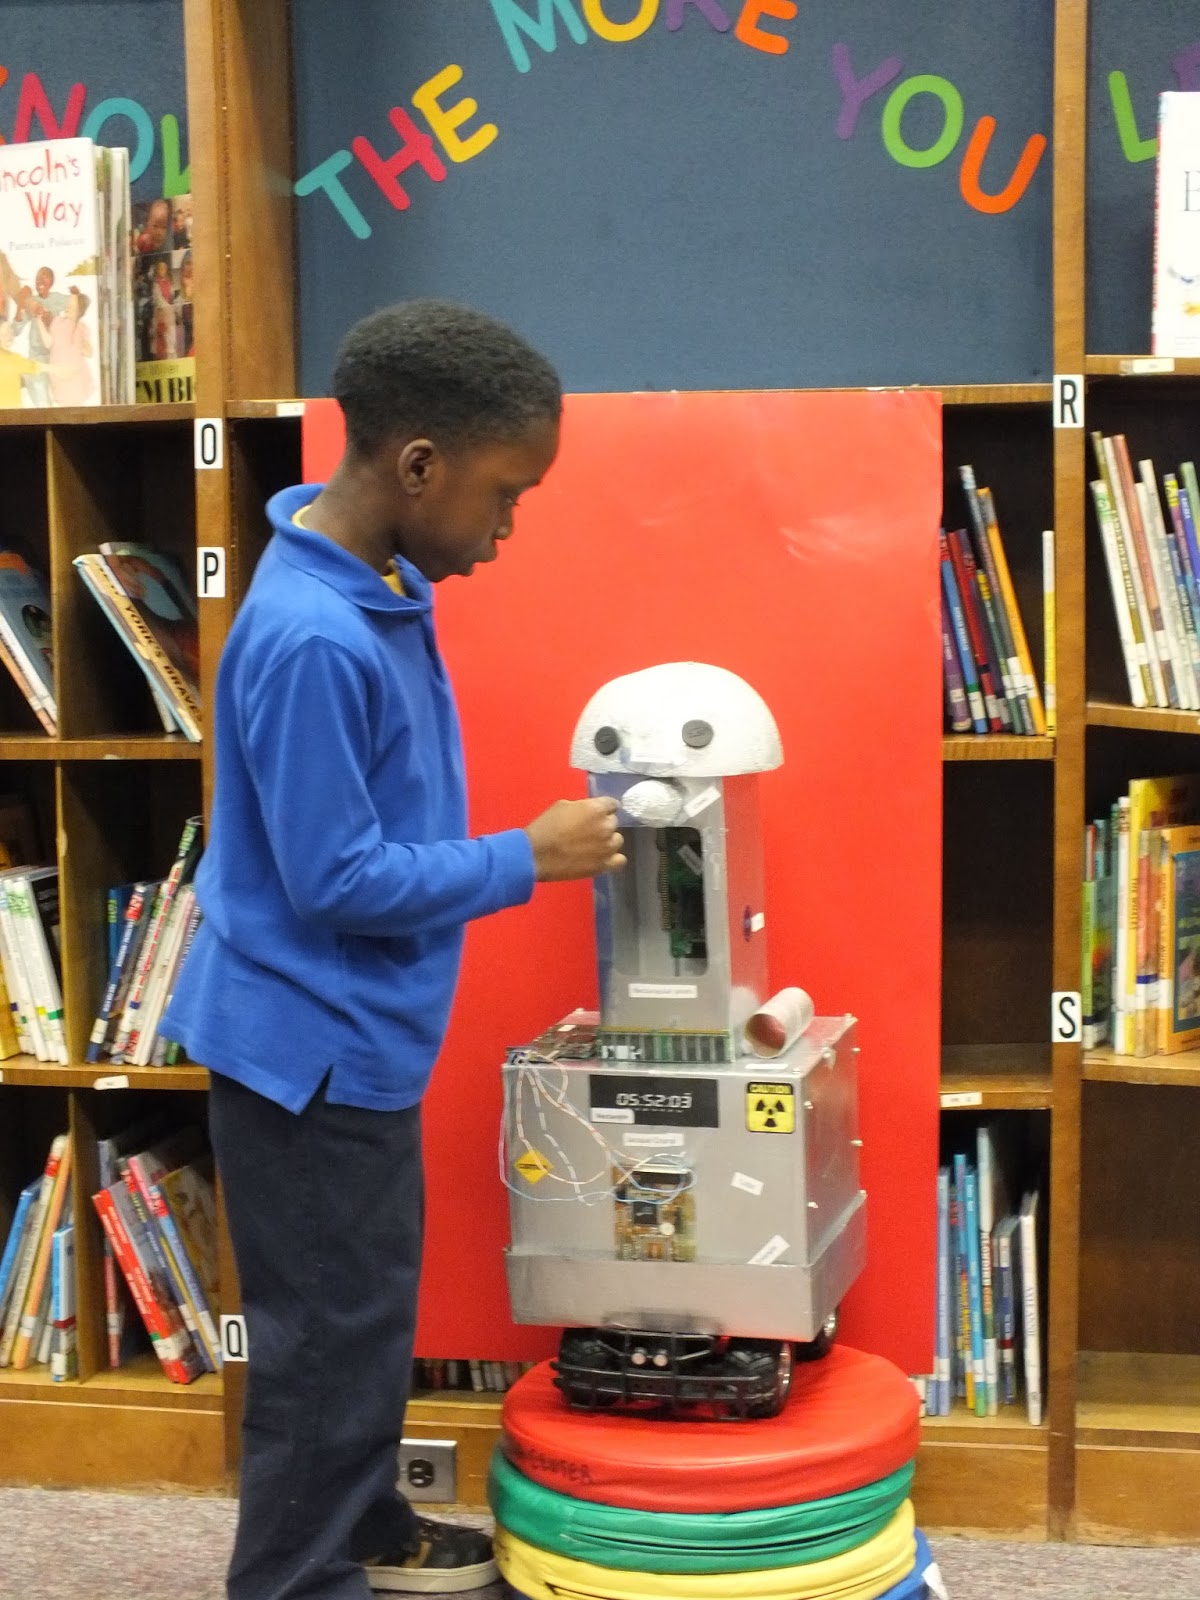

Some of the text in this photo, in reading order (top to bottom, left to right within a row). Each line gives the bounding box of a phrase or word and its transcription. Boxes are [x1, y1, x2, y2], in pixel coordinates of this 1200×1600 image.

[0, 65, 192, 198] NO
[294, 64, 498, 240] THE
[831, 42, 1047, 214] YOU
[0, 149, 81, 192] ncoln's
[25, 191, 83, 228] Way
[1060, 380, 1078, 424] R
[201, 423, 217, 465] O
[203, 551, 218, 594] P
[125, 604, 165, 658] YORK'S
[1059, 997, 1076, 1039] S
[225, 1319, 243, 1358] Q
